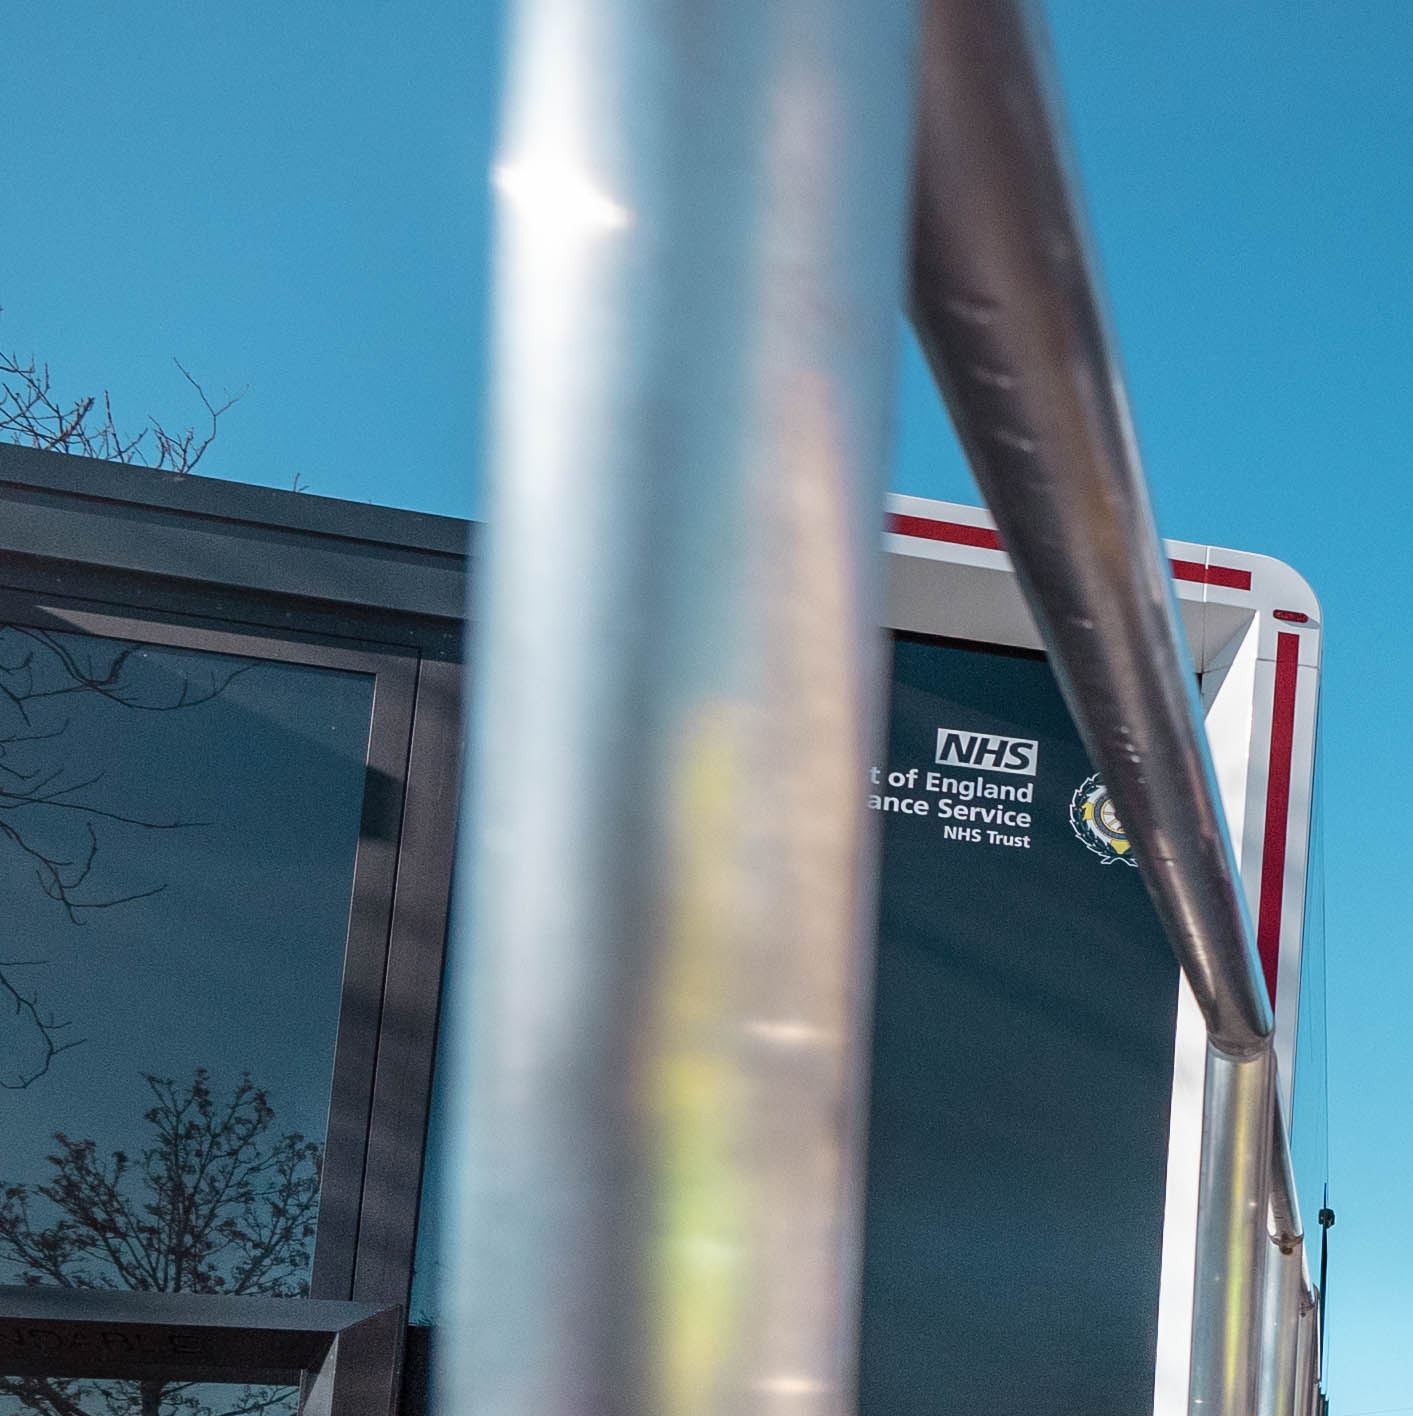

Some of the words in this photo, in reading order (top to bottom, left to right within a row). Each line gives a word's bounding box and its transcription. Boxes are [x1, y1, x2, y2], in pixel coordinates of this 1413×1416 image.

[938, 732, 1034, 771] NHS
[888, 769, 919, 789] of
[926, 772, 1034, 803] England
[938, 798, 1032, 828] Service
[943, 825, 982, 843] NHS
[986, 830, 1031, 849] Trust
